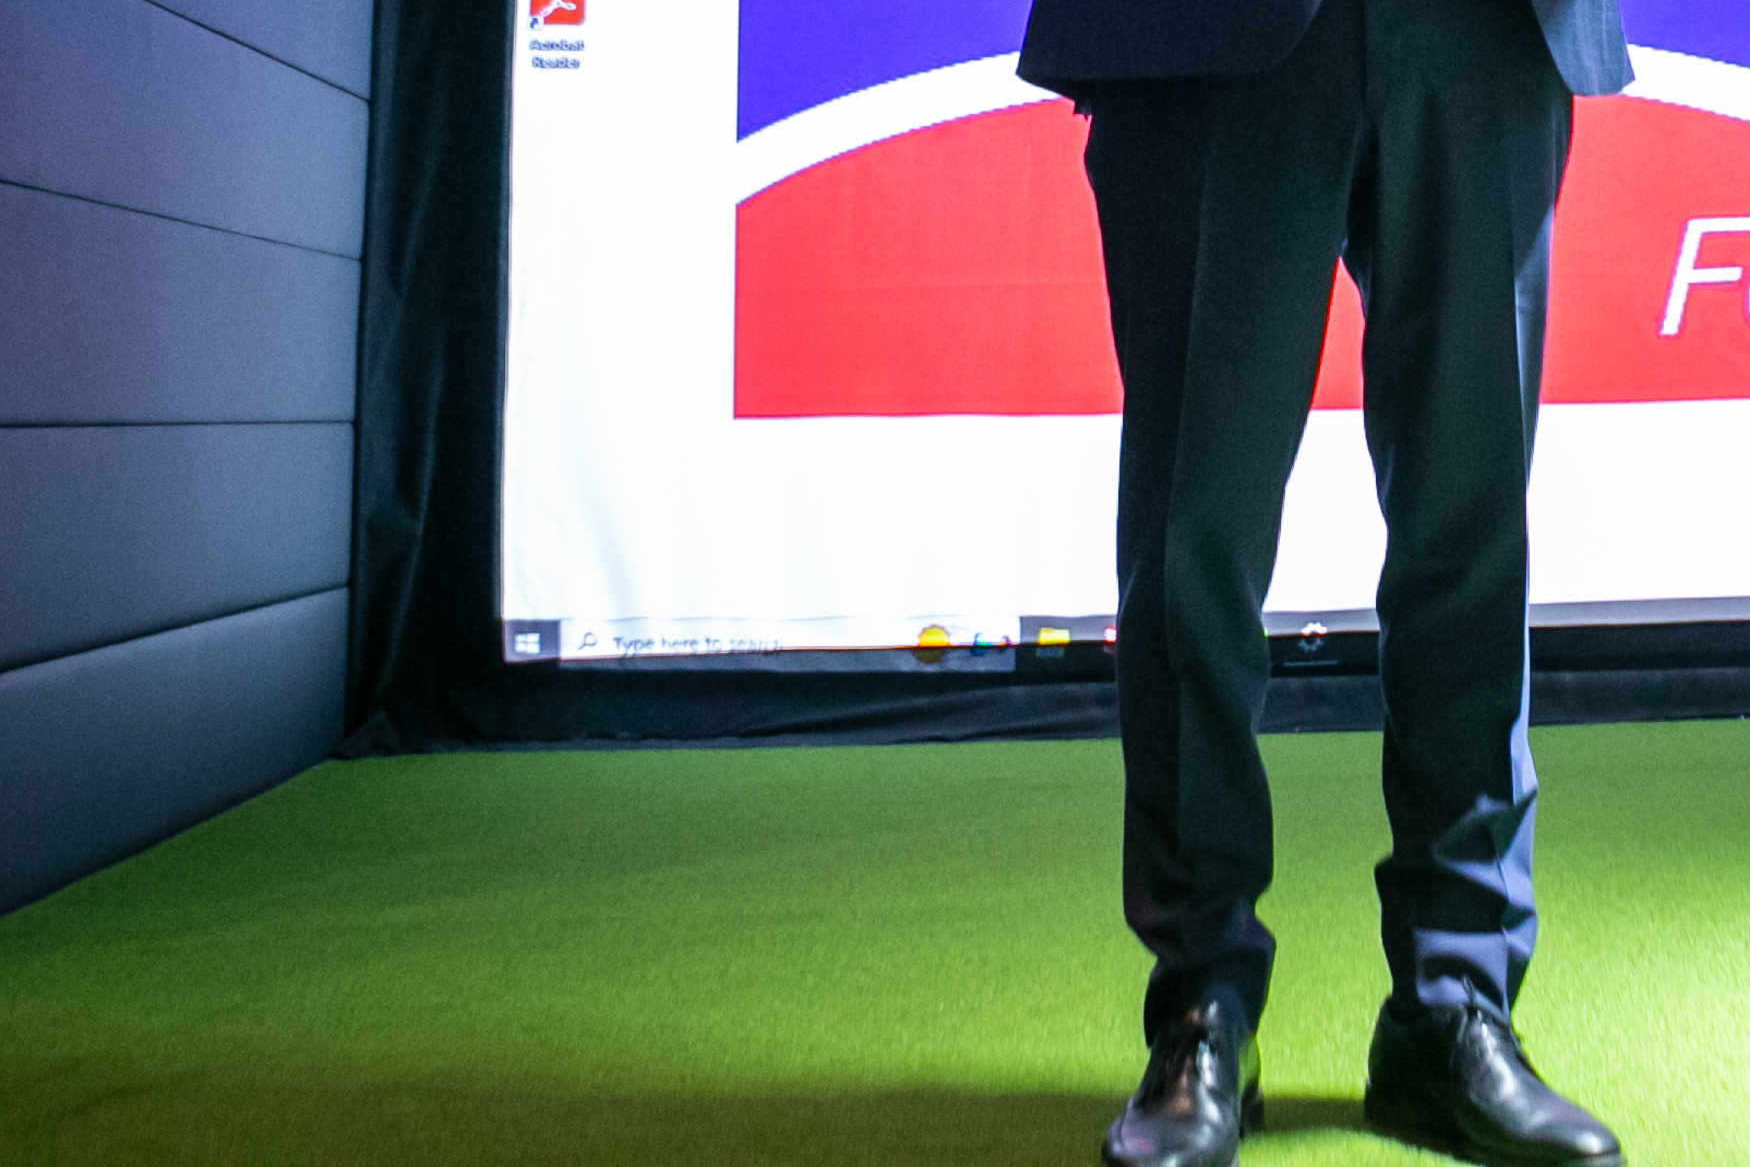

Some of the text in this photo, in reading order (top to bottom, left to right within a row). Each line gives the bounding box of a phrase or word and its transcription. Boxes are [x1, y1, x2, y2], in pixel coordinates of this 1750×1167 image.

[613, 637, 655, 658] Type
[661, 637, 699, 653] here
[705, 637, 722, 653] to
